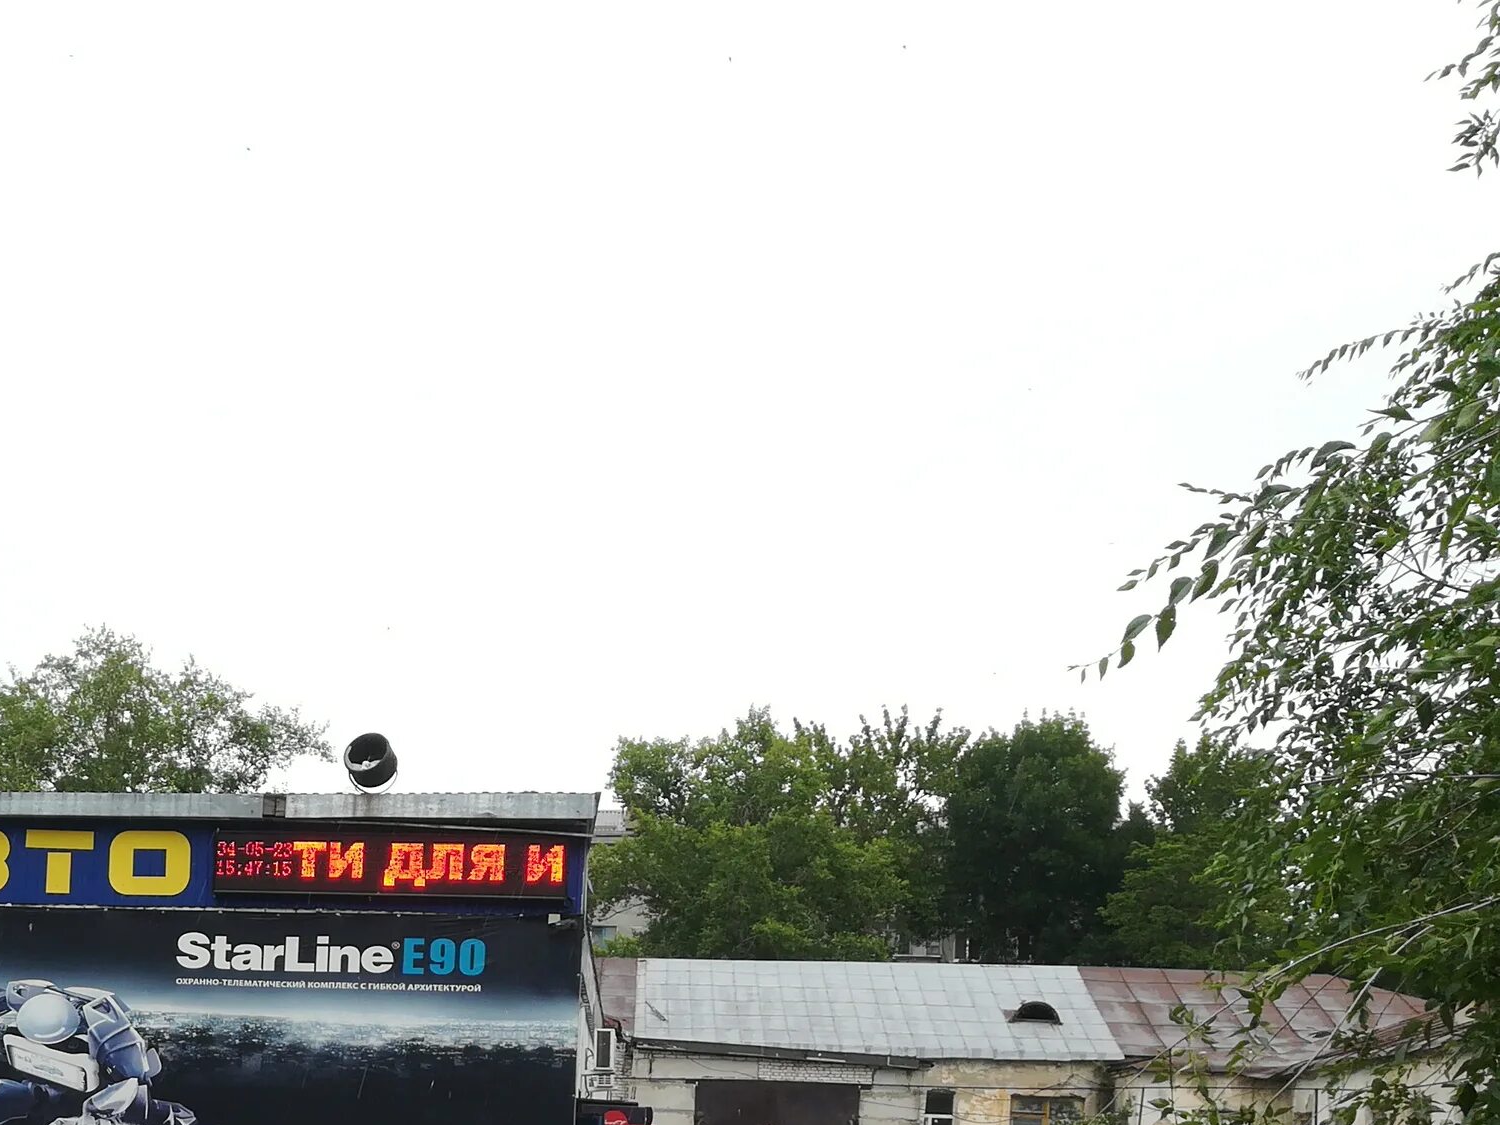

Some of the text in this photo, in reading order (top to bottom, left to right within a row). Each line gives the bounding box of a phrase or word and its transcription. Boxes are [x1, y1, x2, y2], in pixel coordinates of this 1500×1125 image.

[216, 860, 292, 876] 15:47:15
[293, 841, 565, 888] ТИ ДЛЯ И
[402, 936, 487, 976] E90
[175, 977, 306, 989] ОХРАННО-ТЕЛЕМАТИЧЕСКИЙ
[307, 980, 359, 990] КОМПЛЕКС
[368, 981, 406, 991] ГИБКОЙ
[407, 983, 482, 993] АРХИТЕКТУРОЙ
